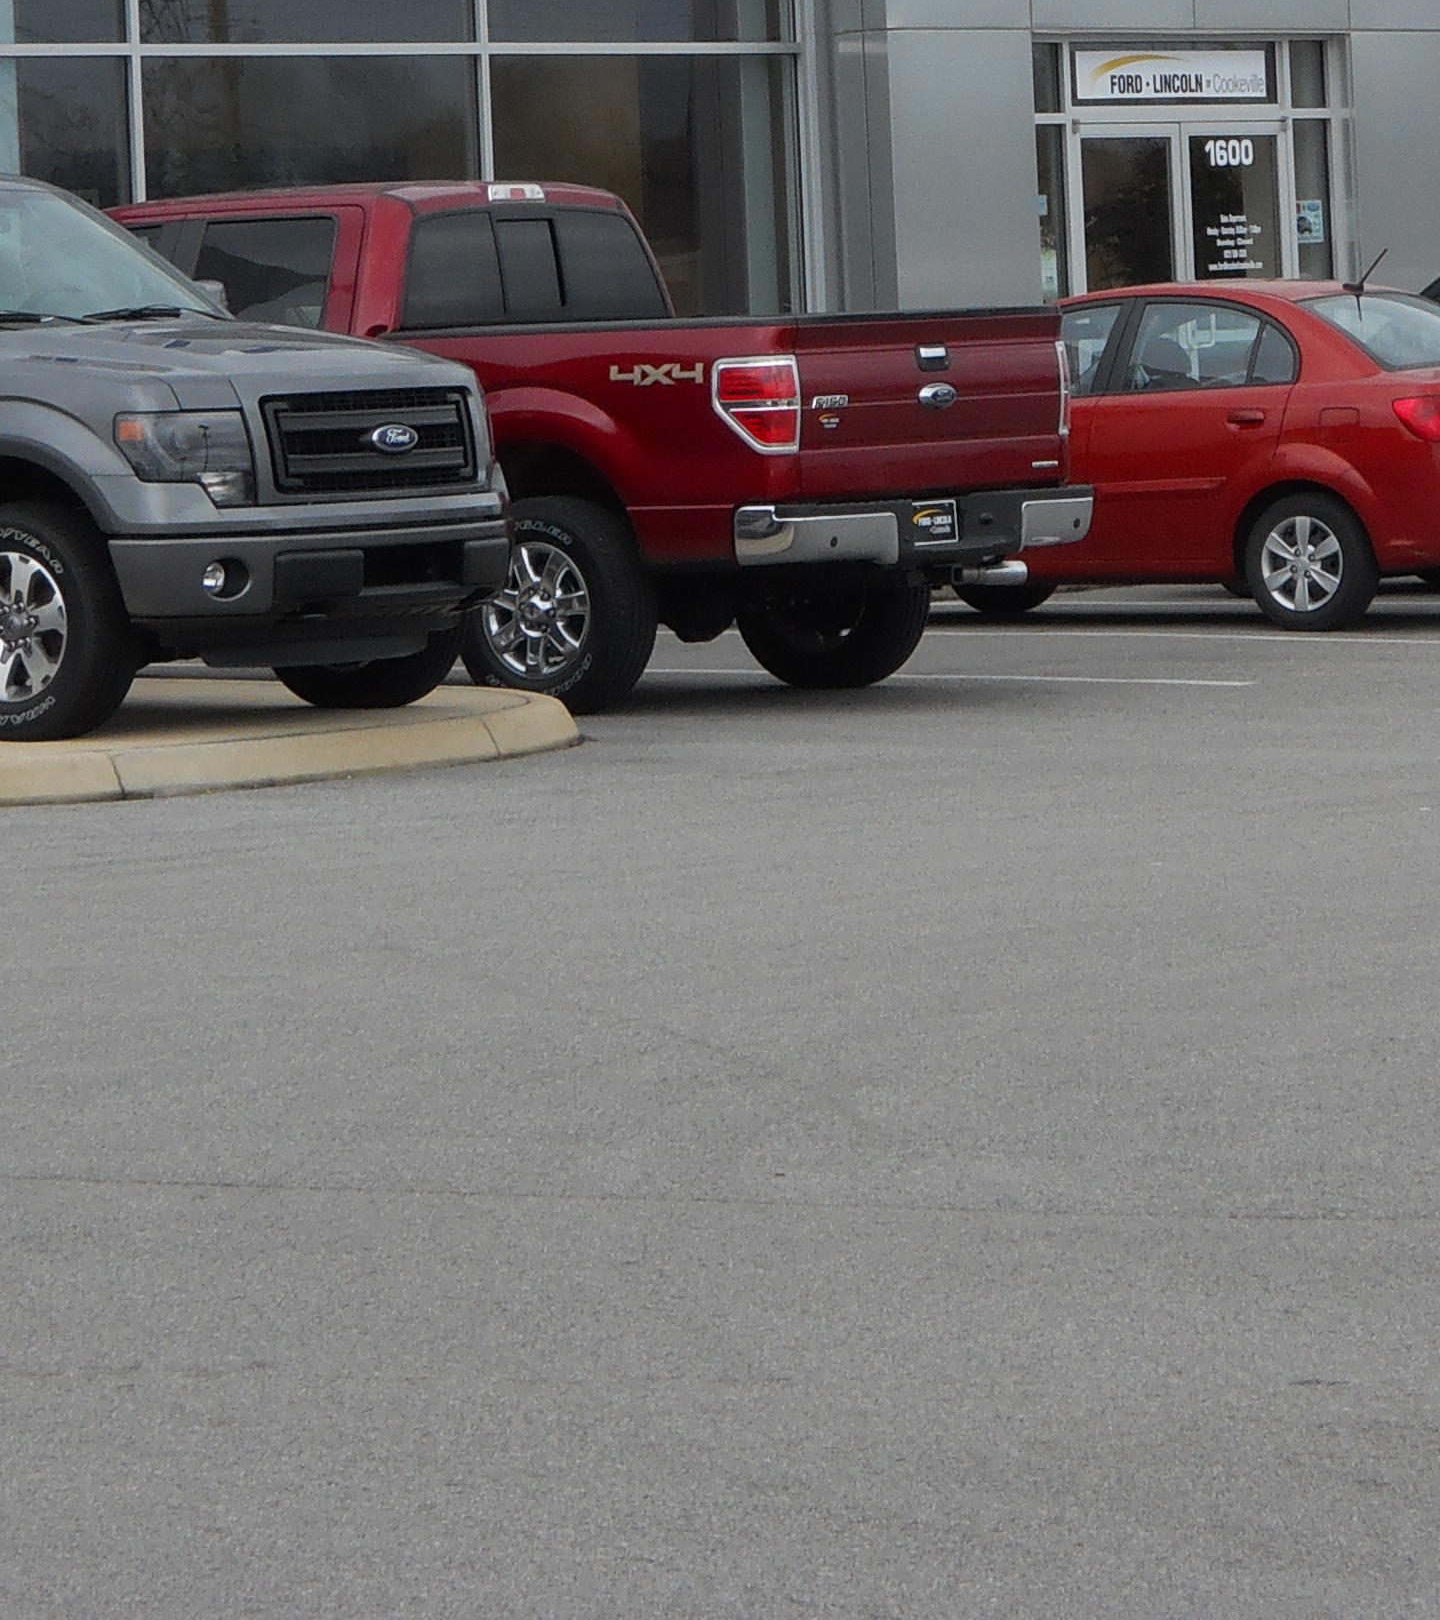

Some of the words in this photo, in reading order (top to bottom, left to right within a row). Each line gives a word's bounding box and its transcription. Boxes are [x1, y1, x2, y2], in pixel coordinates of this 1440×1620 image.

[1110, 73, 1143, 94] FORD
[1152, 73, 1204, 94] LINCOLN
[1212, 73, 1265, 94] Cookeville
[1204, 139, 1254, 167] 1600
